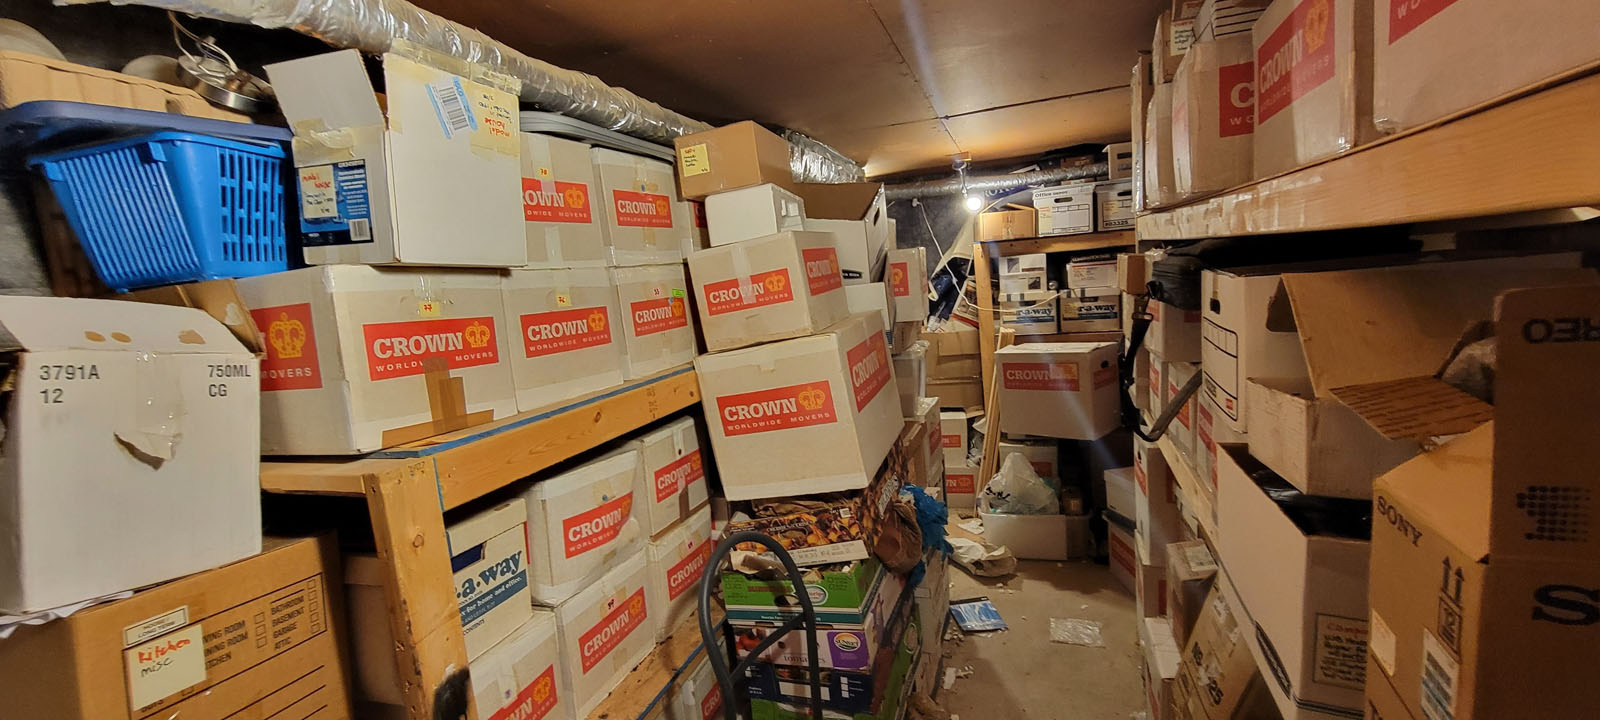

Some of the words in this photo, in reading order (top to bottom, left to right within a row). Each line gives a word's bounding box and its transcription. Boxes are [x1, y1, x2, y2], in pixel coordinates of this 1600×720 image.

[523, 189, 565, 208] OWN
[617, 199, 657, 216] CROWN
[635, 306, 673, 324] CROWN
[527, 318, 589, 342] CROWN
[373, 331, 464, 359] CROWN
[529, 339, 577, 352] WORLDWIDE
[582, 333, 609, 344] MOVERS
[39, 364, 101, 381] 3791A
[207, 364, 252, 378] 750ML
[375, 361, 424, 373] WORLD
[455, 351, 494, 362] MOVERS
[852, 350, 880, 388] CROWN
[39, 388, 64, 404] 12
[208, 384, 228, 398] CG
[724, 397, 798, 422] CROWN
[727, 419, 782, 431] WORLDWIDE
[790, 412, 831, 423] MOVERS
[657, 462, 692, 490] CROWN
[568, 508, 622, 542] CROWN
[1376, 495, 1423, 548] SONY
[670, 553, 704, 588] CROWN
[271, 596, 305, 616] BATHROOM
[271, 606, 305, 627] BASEMENT
[223, 620, 246, 635] ROOM
[272, 621, 298, 639] GARAGE
[583, 609, 630, 657] CROWN
[226, 631, 249, 647] ROOM
[273, 636, 292, 651] ATTIC
[140, 657, 174, 678] misc
[704, 689, 721, 716] CRO
